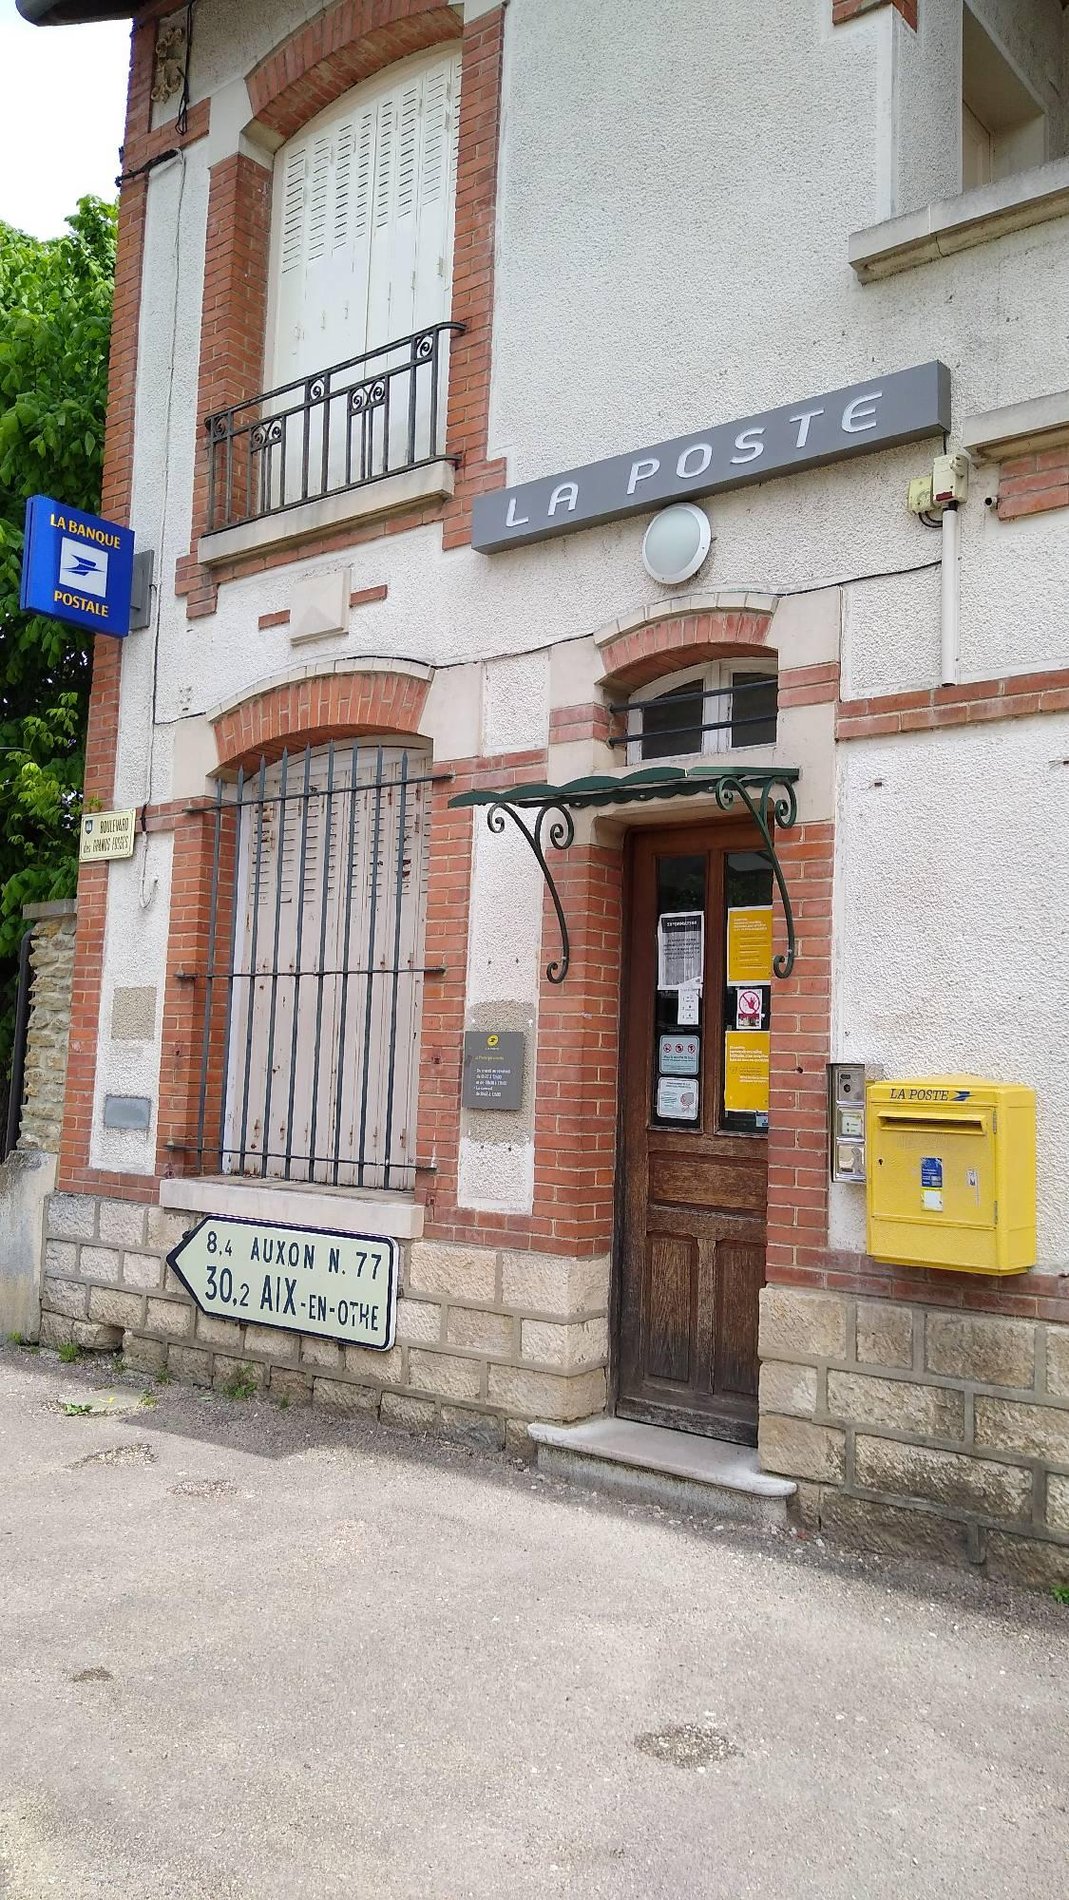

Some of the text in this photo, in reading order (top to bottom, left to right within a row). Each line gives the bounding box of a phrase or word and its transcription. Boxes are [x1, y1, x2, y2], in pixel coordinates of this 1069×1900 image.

[504, 390, 884, 529] LA POSTE
[49, 513, 121, 550] LA BANQUE
[53, 590, 109, 618] POSTALE
[890, 1088, 949, 1101] LA POSTE
[206, 1230, 233, 1257] 8,4
[250, 1237, 316, 1270] AUXON
[356, 1251, 382, 1280] 77
[204, 1265, 379, 1331] 30,2 AIX-EN-OTHE
